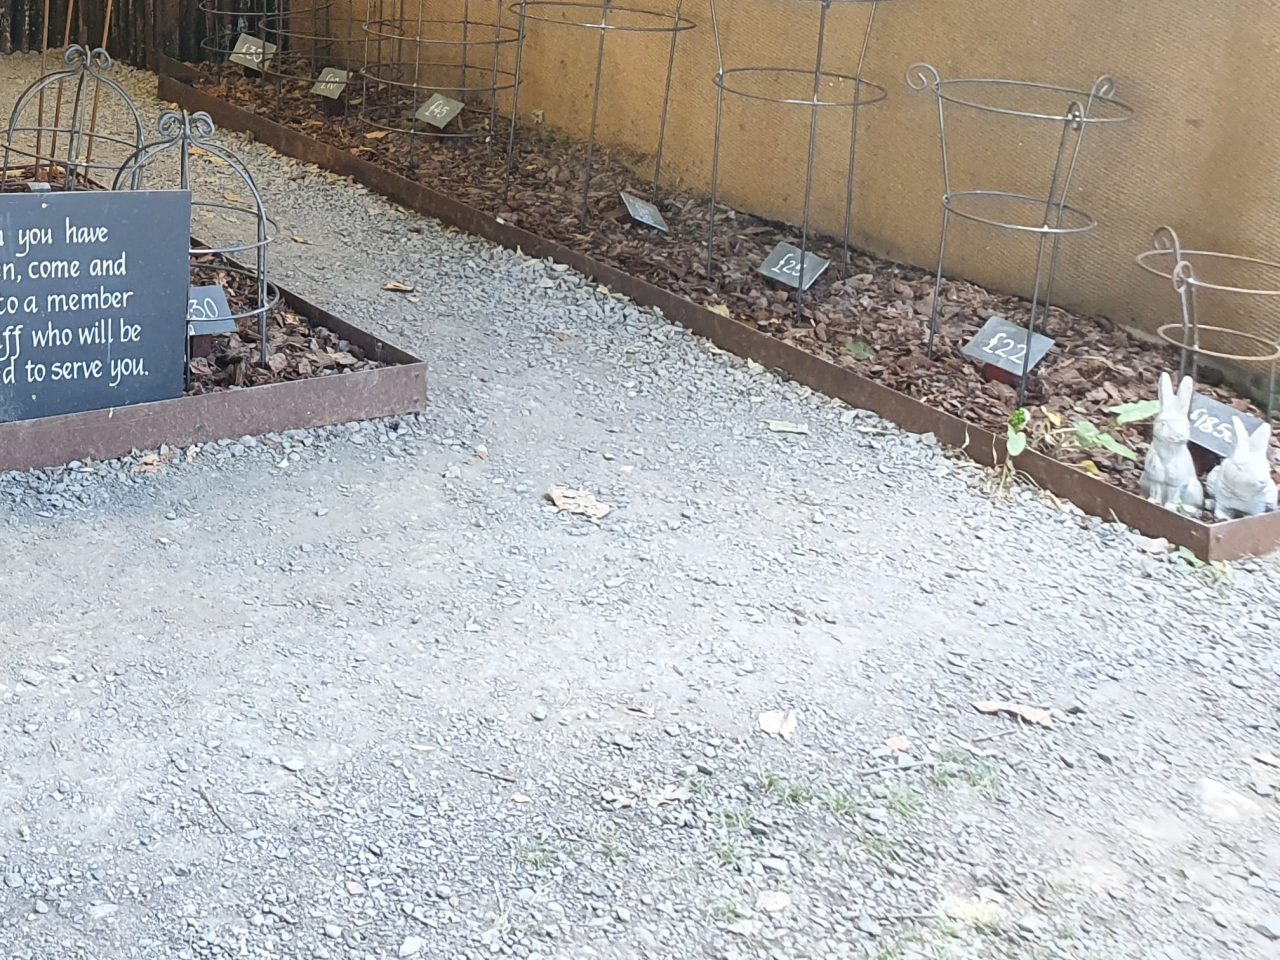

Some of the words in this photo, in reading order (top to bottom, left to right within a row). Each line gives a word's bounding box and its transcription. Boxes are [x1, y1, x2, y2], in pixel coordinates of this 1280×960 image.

[425, 100, 450, 117] £45
[15, 227, 53, 257] you
[65, 217, 108, 245] have
[28, 258, 80, 279] come
[89, 251, 126, 277] and
[24, 296, 38, 314] a
[47, 286, 133, 312] member
[189, 298, 218, 319] 30
[32, 321, 72, 347] who
[79, 318, 113, 345] will
[120, 317, 141, 342] be
[982, 332, 1027, 364] £22
[25, 359, 46, 383] to
[51, 358, 103, 380] serve
[109, 358, 149, 387] you.
